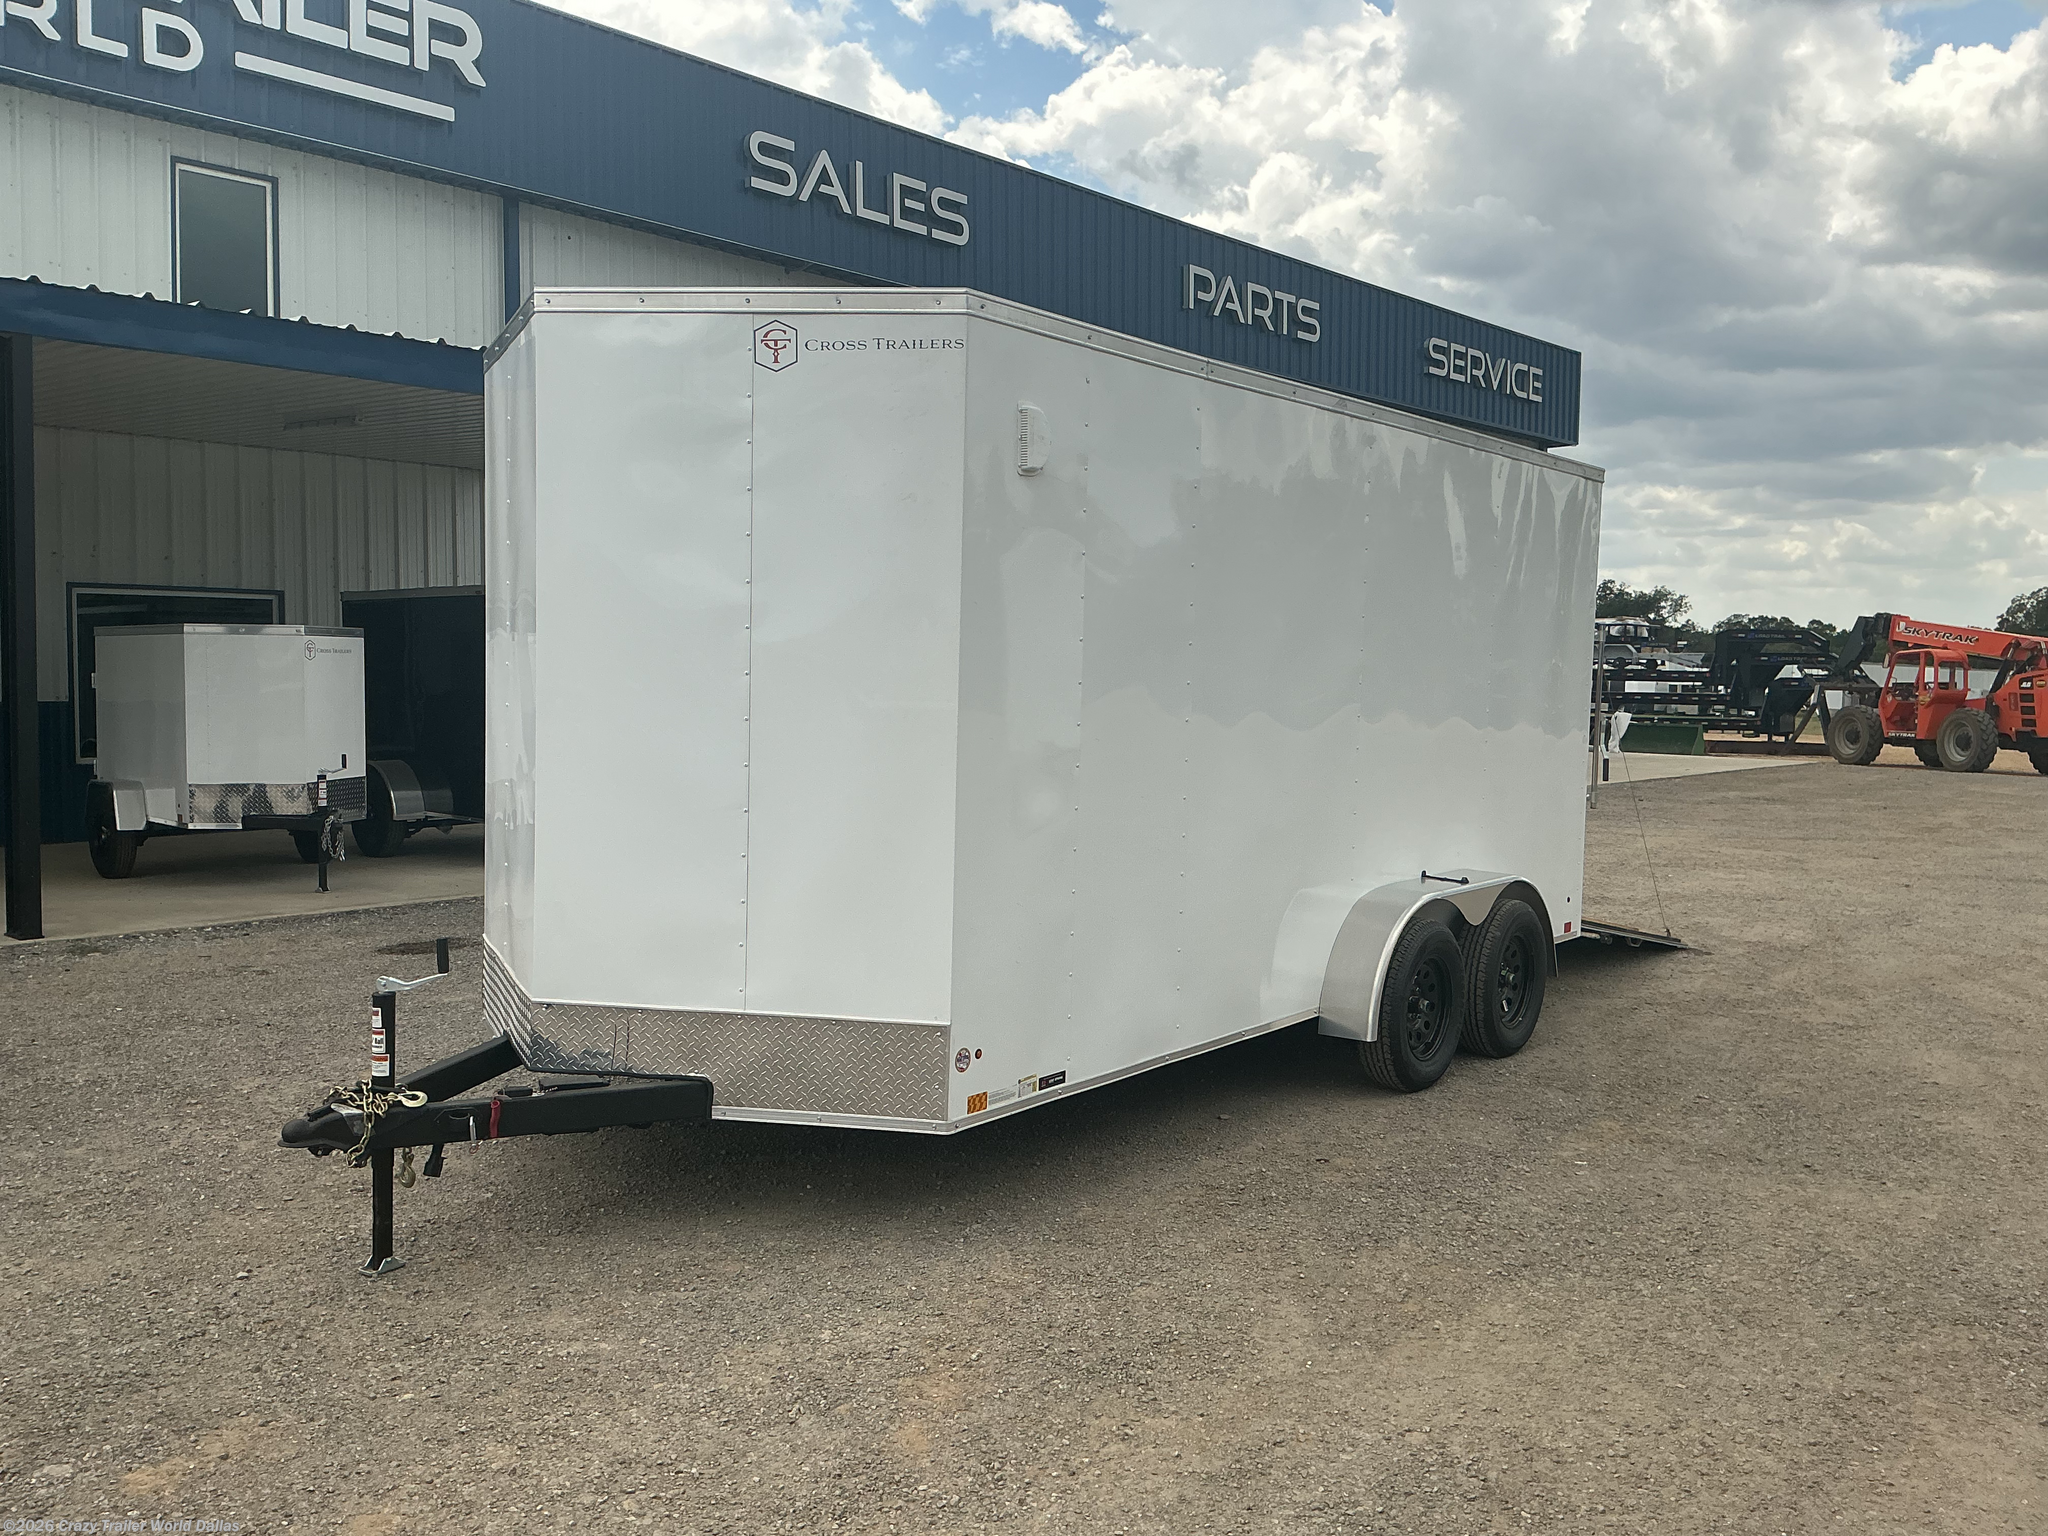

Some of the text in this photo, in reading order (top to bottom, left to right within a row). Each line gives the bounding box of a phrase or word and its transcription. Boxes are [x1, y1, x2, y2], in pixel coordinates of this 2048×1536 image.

[747, 130, 970, 246] SALES
[1186, 264, 1321, 343] PARTS
[1426, 337, 1543, 403] SERVICE
[1902, 626, 1979, 645] SKYTRAK
